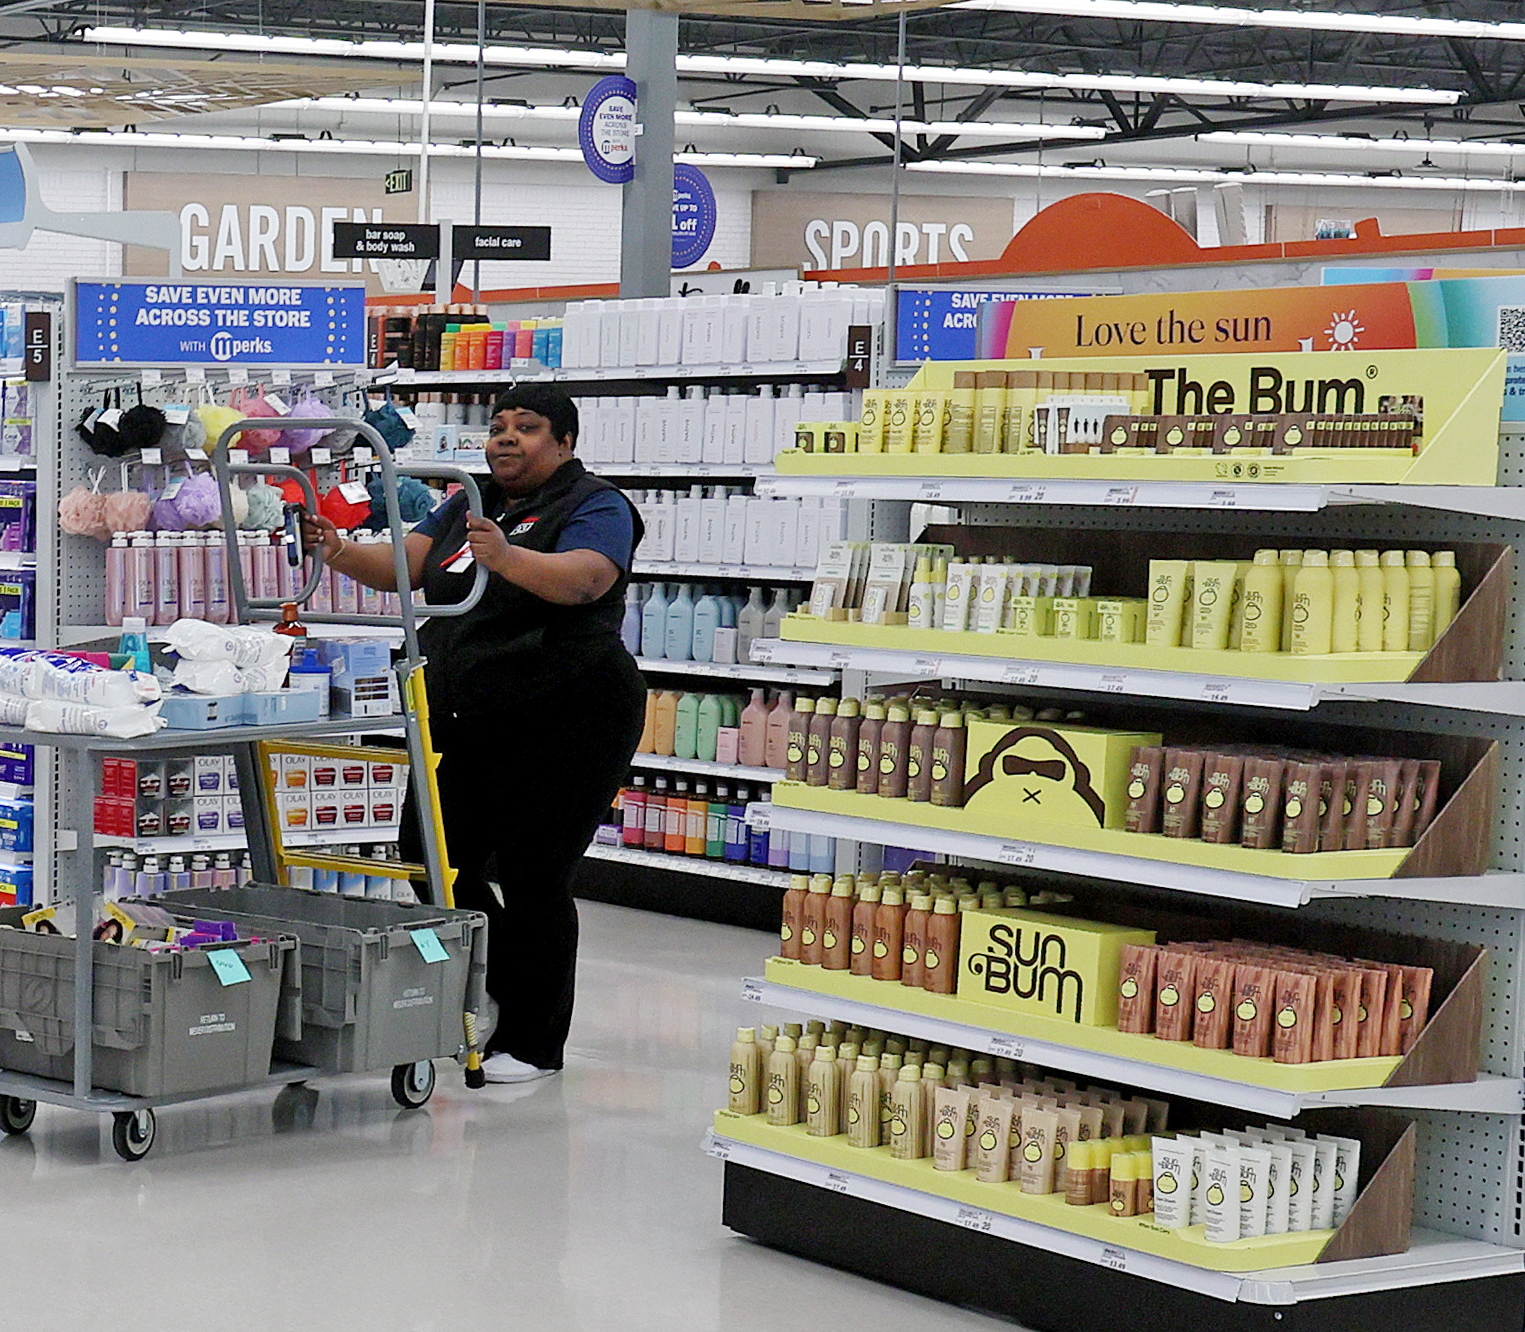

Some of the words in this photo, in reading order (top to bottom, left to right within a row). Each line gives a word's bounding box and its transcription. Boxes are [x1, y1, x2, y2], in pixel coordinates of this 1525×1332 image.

[390, 172, 407, 191] EXIT
[680, 218, 697, 230] off
[366, 229, 381, 239] bar
[383, 231, 405, 242] soap
[356, 242, 364, 251] &
[366, 242, 388, 254] body
[391, 243, 415, 252] wash
[475, 237, 499, 247] facial
[501, 239, 522, 248] care
[803, 219, 974, 271] SPORTS
[145, 286, 192, 304] SAVE
[197, 287, 244, 305] EVEN
[248, 288, 302, 306] MORE
[951, 293, 989, 308] SAVE
[135, 308, 211, 326] ACROSS
[214, 309, 250, 327] THE
[253, 310, 311, 327] STORE
[33, 329, 43, 344] E
[1076, 312, 1147, 349] Love
[1155, 311, 1205, 346] the
[1211, 316, 1273, 342] sun
[180, 341, 206, 352] WITH
[855, 341, 864, 354] E
[33, 350, 42, 363] 5
[854, 358, 864, 371] 4
[1145, 369, 1234, 416] The
[198, 758, 220, 766] OLAY
[285, 755, 305, 765] OLAY
[287, 794, 307, 803] OLAY
[316, 792, 336, 801] OLAY
[344, 791, 365, 801] OLAY
[373, 790, 393, 799] OLAY
[198, 797, 220, 806] OLAY
